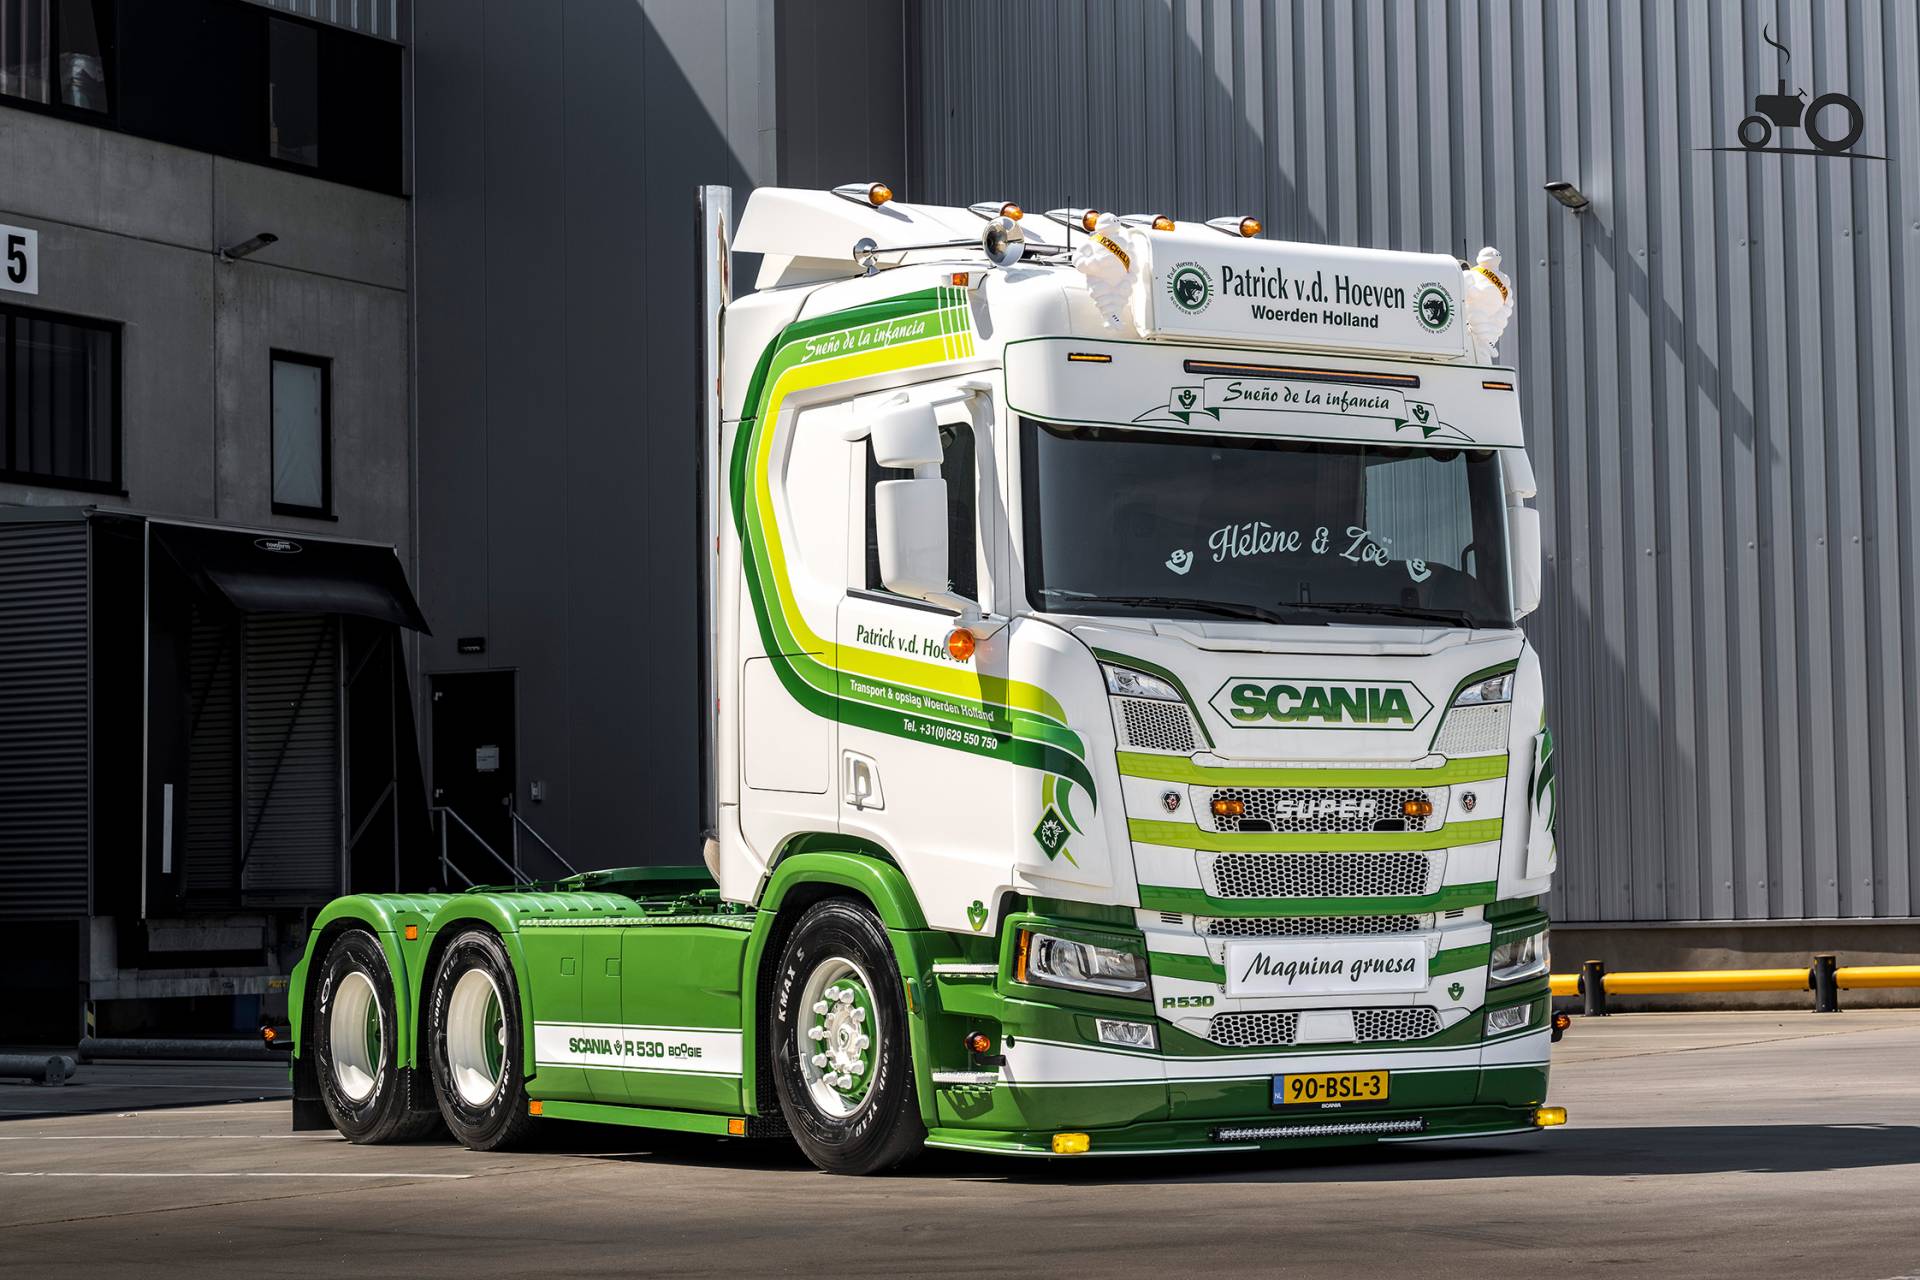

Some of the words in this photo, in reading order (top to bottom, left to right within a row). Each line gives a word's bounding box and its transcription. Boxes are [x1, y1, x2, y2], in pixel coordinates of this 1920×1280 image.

[7, 234, 28, 284] 5
[1221, 265, 1289, 300] Patrick
[1294, 270, 1329, 304] v.d.
[1335, 274, 1405, 310] Hoeven
[1251, 304, 1318, 324] Woerden
[1323, 310, 1379, 329] Holland
[801, 337, 840, 363] Sueño
[843, 331, 855, 350] de
[858, 330, 870, 346] la
[873, 319, 926, 347] infancia
[1222, 381, 1279, 404] Sueño
[1283, 386, 1300, 404] de
[1305, 390, 1321, 405] la
[1326, 390, 1390, 412] infancia
[1208, 521, 1302, 563] Hélène
[1311, 526, 1329, 555] &
[1339, 525, 1393, 567] Zoë
[856, 624, 896, 650] Patrick
[898, 634, 919, 655] v.d.
[923, 637, 969, 665] Hoe
[850, 679, 887, 699] Transport
[887, 687, 894, 700] &
[895, 692, 922, 709] opslag
[922, 696, 960, 716] Woerden
[960, 704, 995, 723] Holland
[1229, 683, 1415, 724] SCANIA
[903, 718, 918, 733] Tel.
[919, 723, 962, 743] +31(0)629
[963, 732, 980, 747] 550
[981, 736, 999, 751] 750
[1275, 799, 1377, 819] SUPER
[1241, 951, 1344, 986] Maquina
[1350, 956, 1416, 983] gruesa
[778, 965, 797, 1023] KMAX
[1162, 995, 1215, 1009] R530
[569, 1036, 614, 1056] SCANIA
[625, 1040, 635, 1057] R
[636, 1041, 665, 1058] 530
[668, 1042, 702, 1058] BOOGIE
[1291, 1075, 1381, 1100] 90-BSL-3
